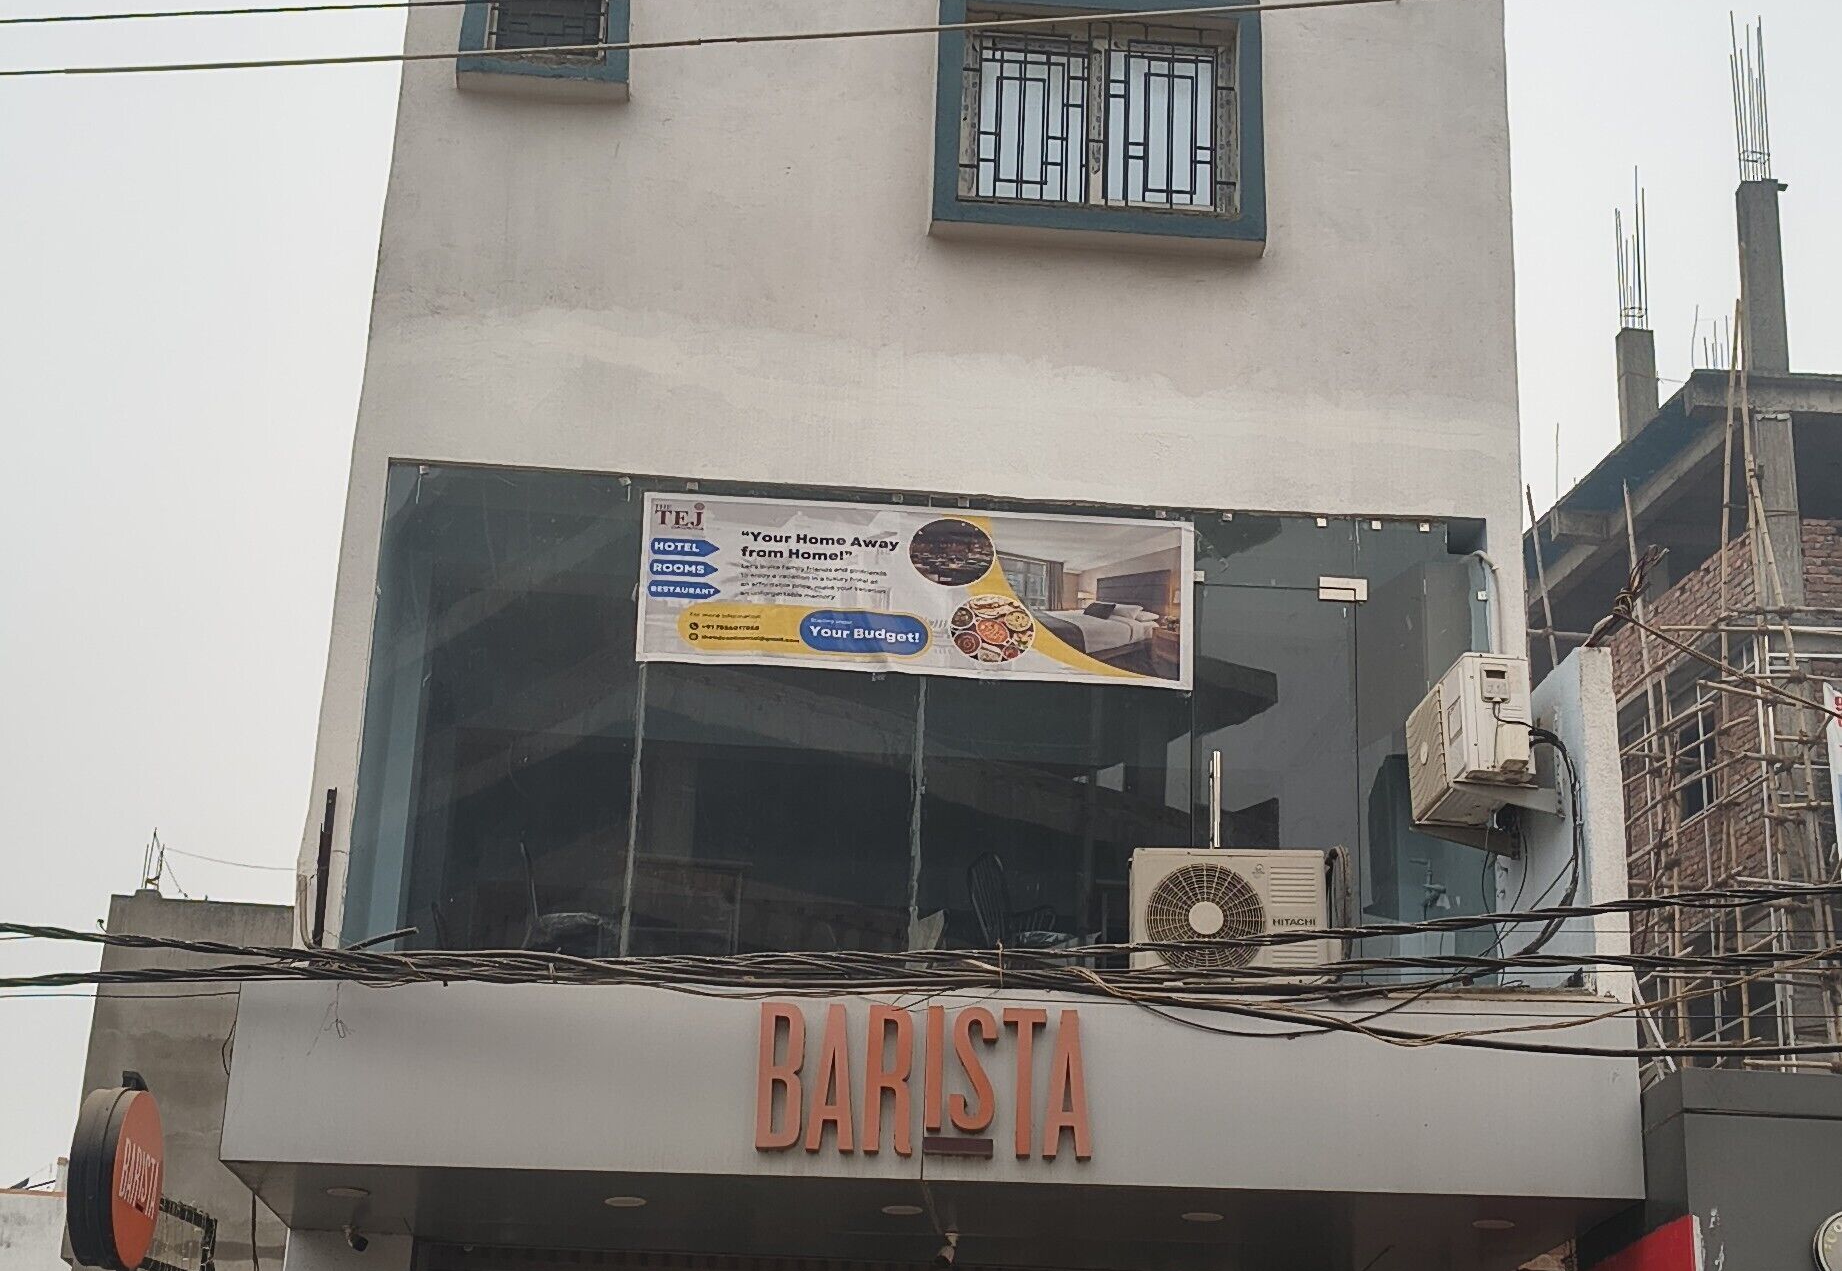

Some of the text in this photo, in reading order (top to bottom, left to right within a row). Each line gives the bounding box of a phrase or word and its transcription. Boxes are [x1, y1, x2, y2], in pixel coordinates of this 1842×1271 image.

[655, 509, 705, 528] TEJ
[654, 541, 700, 553] HOTEL
[741, 530, 900, 552] “Your Home Away
[741, 545, 853, 561] from Home!”
[653, 562, 705, 575] ROOMS
[651, 585, 715, 596] RESTAURANT
[810, 625, 920, 643] Your Budget!
[1272, 917, 1316, 927] HITACHI
[755, 1001, 1092, 1161] BARISTA
[118, 1137, 160, 1220] BARISTA
